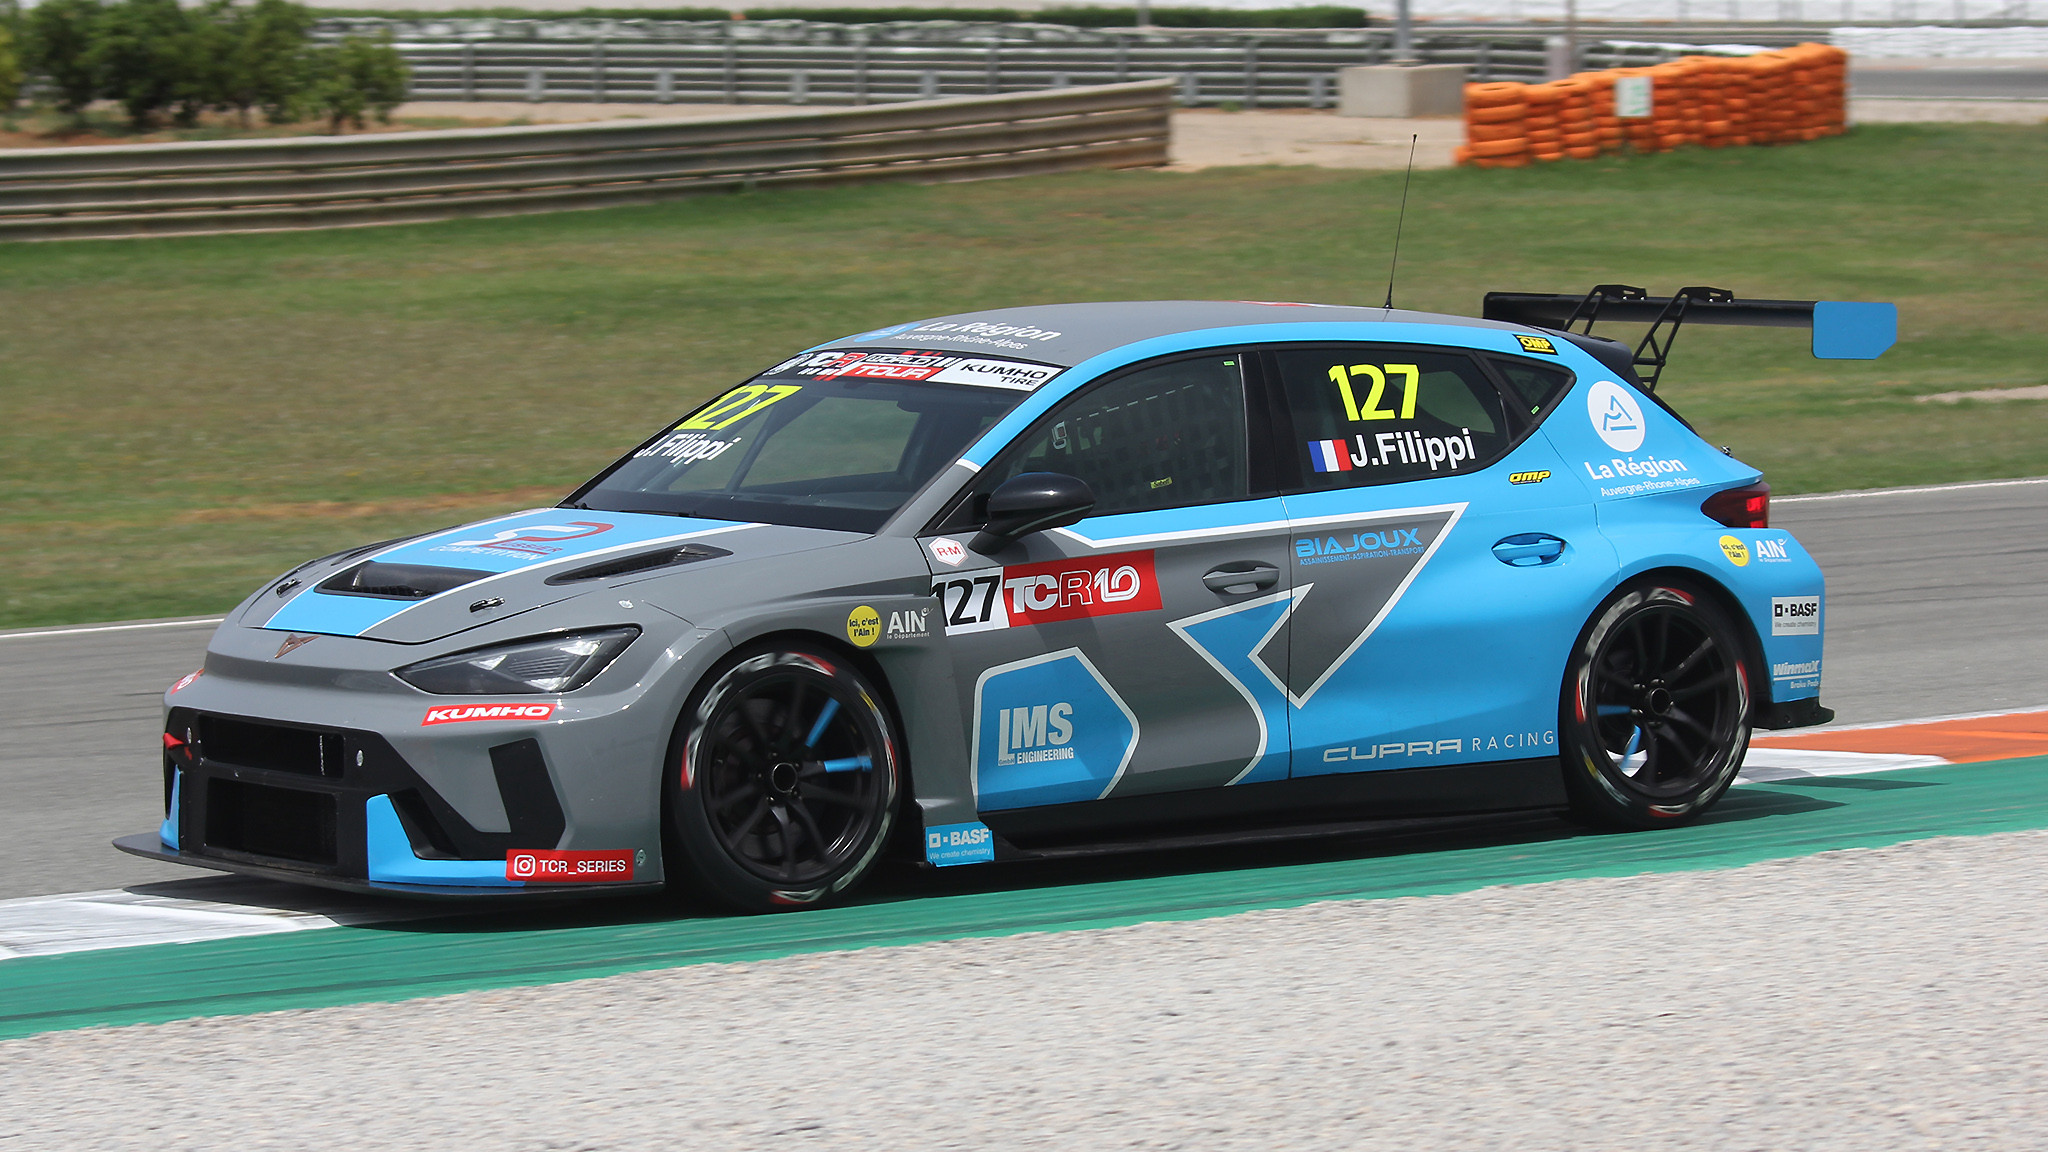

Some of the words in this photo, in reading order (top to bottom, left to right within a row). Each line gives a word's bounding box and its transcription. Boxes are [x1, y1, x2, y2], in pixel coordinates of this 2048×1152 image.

[913, 321, 958, 332] La
[951, 322, 1062, 341] Région
[1519, 337, 1551, 350] OMP
[855, 365, 932, 378] TOUR
[960, 363, 1048, 379] KUMHO
[1001, 375, 1039, 387] TIRE
[1328, 364, 1420, 421] 127
[1350, 427, 1476, 471] J.Filippi
[1584, 461, 1615, 480] La
[1611, 455, 1688, 478] Région
[1296, 527, 1423, 558] BIAJOUX
[1755, 539, 1787, 558] AIN
[930, 574, 1001, 627] 127
[1790, 602, 1818, 617] BASF
[887, 609, 927, 634] AIN
[426, 706, 550, 722] KUMHO
[998, 702, 1074, 767] LMS
[1016, 746, 1075, 765] ENGINEERING
[1322, 738, 1462, 763] CUPRA
[1472, 730, 1554, 752] RACING
[950, 828, 990, 846] BASF
[539, 859, 626, 875] TCR_SERIES
